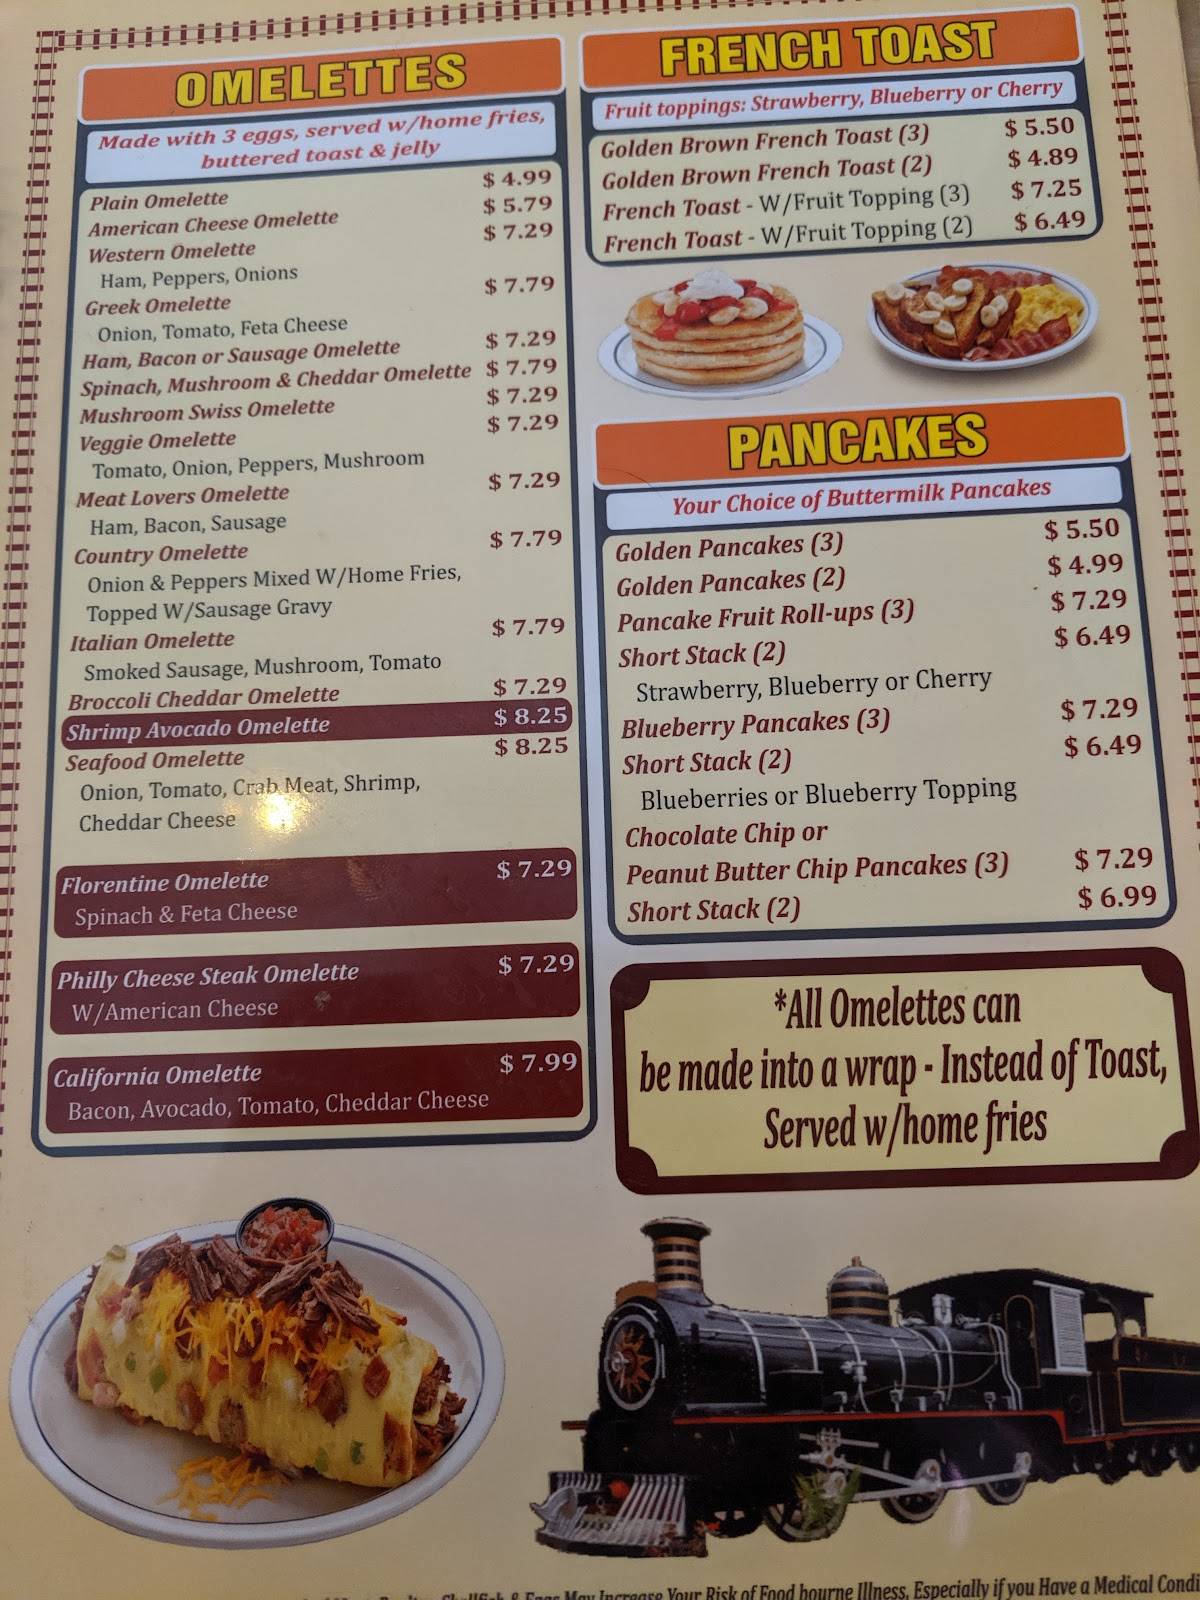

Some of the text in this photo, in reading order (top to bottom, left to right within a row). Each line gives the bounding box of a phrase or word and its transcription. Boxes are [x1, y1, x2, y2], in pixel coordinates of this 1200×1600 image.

[661, 21, 995, 76] FRENCH TOAST
[176, 52, 467, 108] OMELETTES
[605, 80, 1063, 120] Fruit toppings: Strawberry, Blueberry or Cherry
[98, 109, 545, 150] Made with 3 eggs, served w/home fries,
[601, 123, 929, 159] Golden Brown French Toast (3)
[1004, 116, 1075, 138] $ 5.50
[201, 139, 441, 170] buttered toast & jelly
[1008, 147, 1078, 170] $ 4.89
[483, 169, 552, 189] $ 4.99
[89, 191, 229, 212] Plain Omelette
[483, 195, 553, 216] $ 5.79
[603, 200, 675, 222] French
[683, 198, 741, 217] Toast
[759, 191, 844, 217] W/Fruit
[848, 187, 934, 212] Topping
[940, 183, 970, 208] (3)
[80, 363, 472, 401] Spinach, Mushroom & Cheddar Omelette
[80, 431, 237, 456] Veggie Omelette
[727, 412, 988, 469] PANCAKES
[673, 478, 1052, 516] Your Choice of Buttermilk Pancakes
[616, 531, 843, 563] Golden Pancakes (3)
[88, 564, 461, 594] Onion & Peppers Mixed W/Home Fries,
[86, 598, 333, 626] Topped W/Sausage Gravy
[617, 598, 914, 633] Pancake Fruit Roll-ups (3)
[84, 654, 442, 682] Smoked Sausage, Mushroom, Tomato
[618, 640, 786, 668] Short Stack (2)
[67, 686, 340, 711] Broccoli Cheddar Omelette
[637, 668, 992, 703] Strawberry, Blueberry or Cherry
[66, 716, 330, 744] Shrimp Avocado Omelette
[621, 707, 890, 740] Blueberry Pancakes (3)
[641, 779, 1017, 811] Blueberries or Blueberry Topping
[79, 811, 236, 833] Cheddar Cheese
[625, 821, 829, 848] Chocolate Chip or
[60, 871, 269, 895] Florentine Omelette
[626, 851, 1009, 885] Peanut Butter Chip Pancakes (3)
[1078, 885, 1157, 911] $ 6.99
[75, 902, 298, 931] Spinach & Feta Cheese
[57, 962, 359, 994] Philly Cheese Steak Omelette
[72, 998, 279, 1027] W/American Cheese
[830, 984, 966, 1028] Omelettes
[973, 993, 1021, 1024] can
[54, 1063, 262, 1092] California Omelette
[639, 1050, 671, 1093] be
[678, 1047, 753, 1092] made
[760, 1047, 814, 1089] into
[821, 1056, 838, 1088] a
[844, 1054, 917, 1098] wrap
[940, 1038, 1044, 1084] Instead
[1051, 1037, 1080, 1093] of
[1084, 1038, 1167, 1085] Toast,
[68, 1089, 489, 1122] Bacon, Avocado, Tomato, Cheddar Cheese
[764, 1099, 1047, 1158] Served w/home fries
[742, 1584, 759, 1600] of
[760, 1583, 796, 1600] Food
[800, 1583, 853, 1600] bourne
[857, 1581, 909, 1600] Illness,
[914, 1579, 989, 1600] Especially
[993, 1577, 1005, 1600] if
[1008, 1582, 1034, 1600] you
[1039, 1577, 1076, 1597] Have
[1080, 1581, 1090, 1596] a
[1094, 1574, 1153, 1595] Medical
